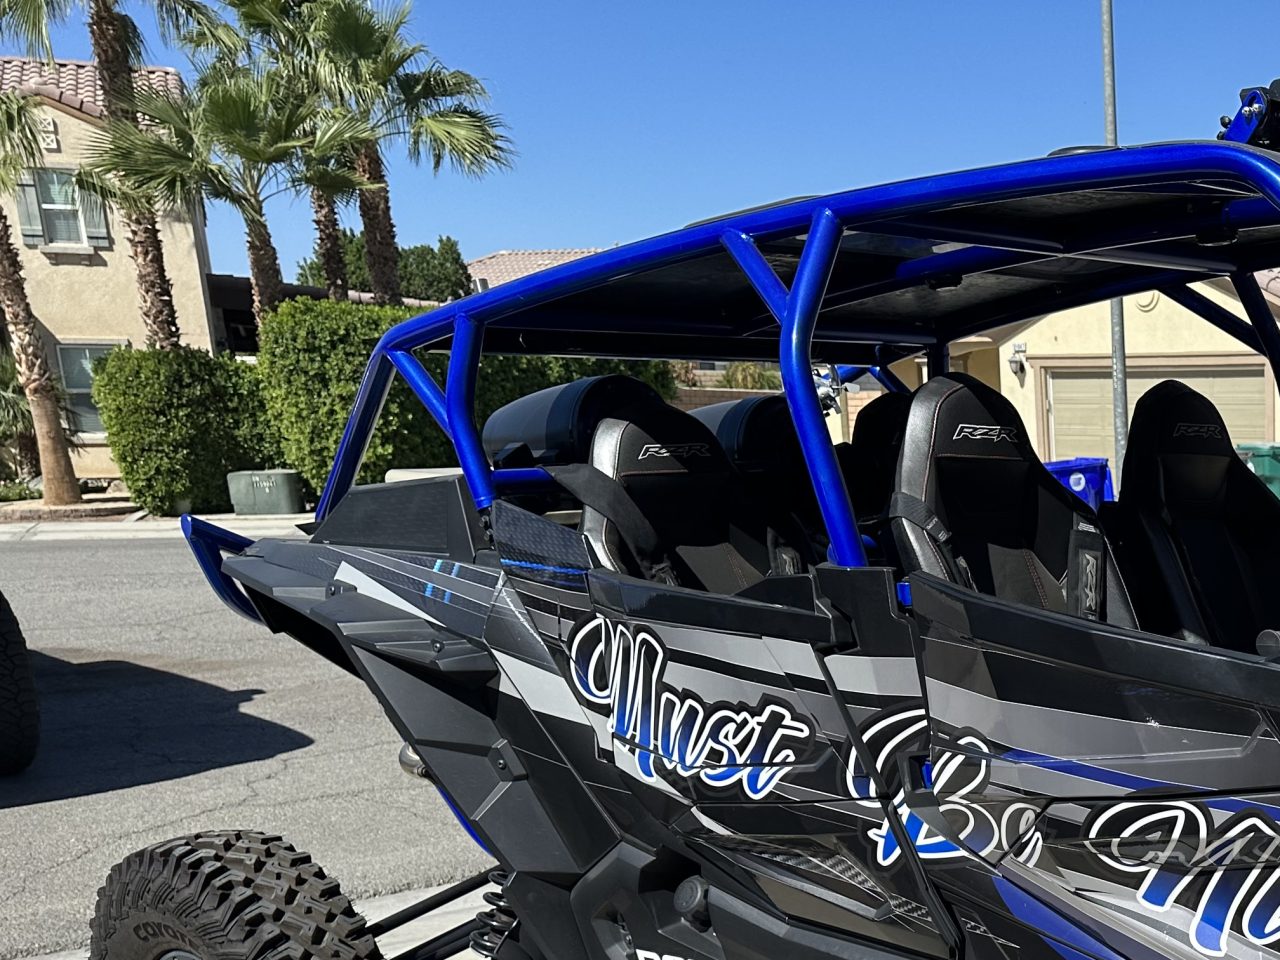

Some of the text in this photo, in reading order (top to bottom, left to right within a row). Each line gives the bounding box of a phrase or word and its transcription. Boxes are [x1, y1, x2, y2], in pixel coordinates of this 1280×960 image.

[952, 423, 1018, 442] RZR
[1173, 422, 1222, 439] RZR
[638, 443, 712, 460] RZR
[570, 612, 810, 800] Must
